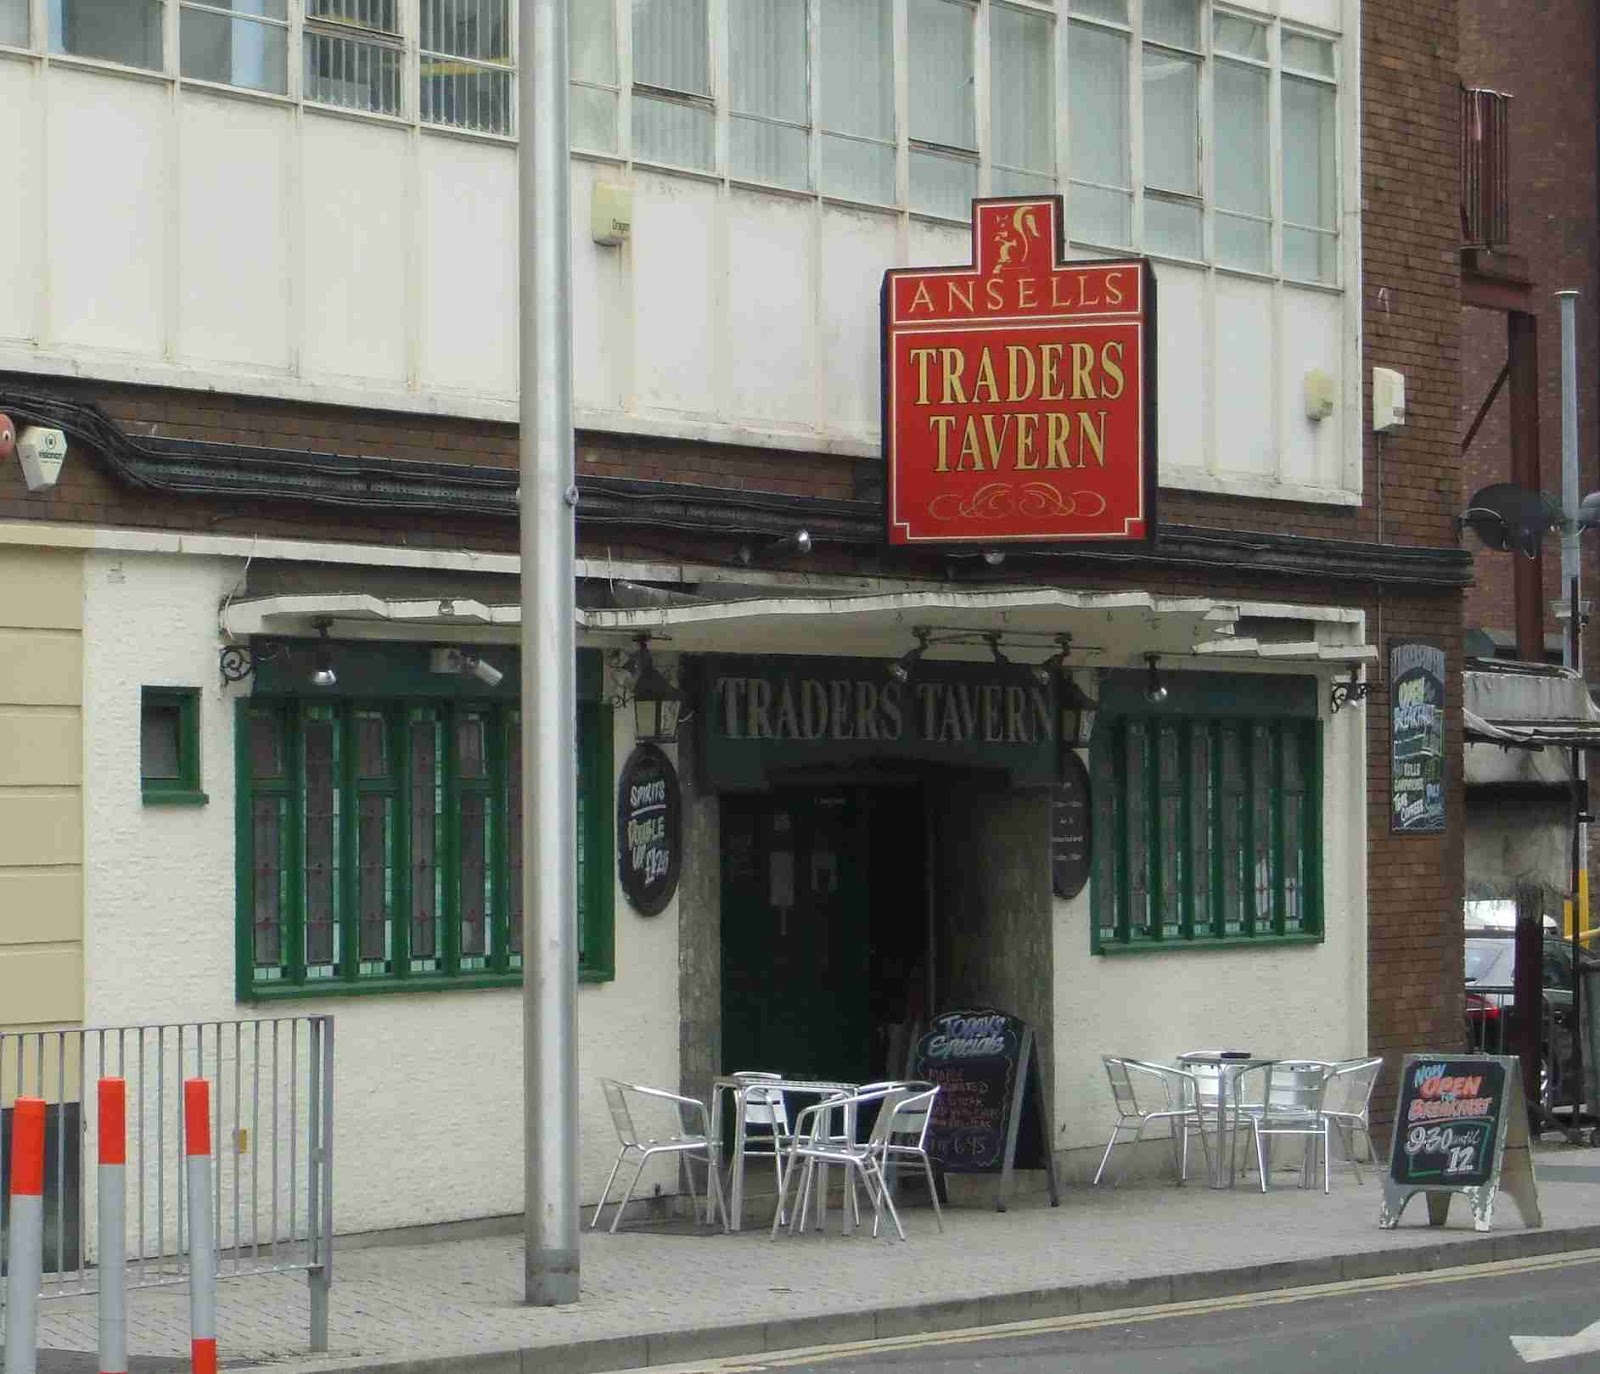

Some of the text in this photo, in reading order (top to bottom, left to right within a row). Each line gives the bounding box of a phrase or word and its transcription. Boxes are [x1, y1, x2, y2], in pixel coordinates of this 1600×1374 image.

[908, 272, 1124, 314] ANSELLS
[910, 341, 1126, 405] TRADERS
[930, 411, 1108, 472] TAVERN
[713, 677, 1055, 742] TRADERS TAVERN
[630, 780, 666, 807] SPIRITS
[627, 816, 665, 851] DOUBLE
[1414, 1063, 1447, 1088] NOW
[1420, 1076, 1483, 1097] OPEN
[1446, 1146, 1474, 1173] 12
